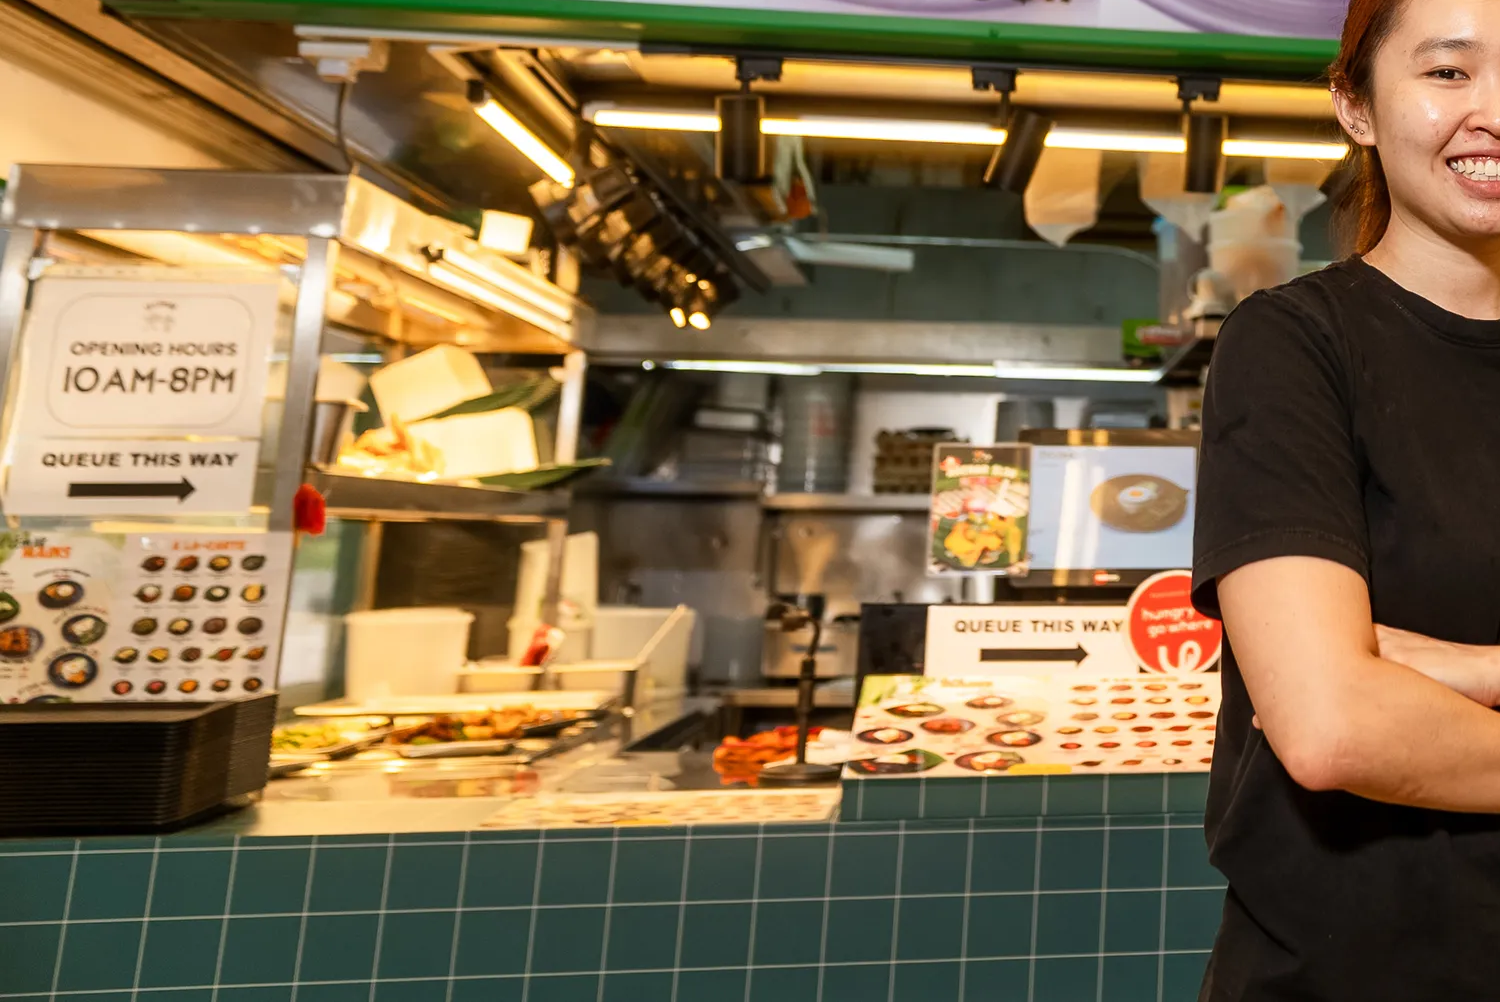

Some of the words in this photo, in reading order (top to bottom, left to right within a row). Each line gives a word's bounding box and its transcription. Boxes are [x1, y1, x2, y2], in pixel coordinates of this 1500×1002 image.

[70, 341, 163, 357] OPENING
[168, 342, 239, 358] HOURS
[41, 452, 122, 468] QUEUE
[130, 452, 182, 468] THIS
[188, 452, 240, 468] WAY
[1141, 607, 1197, 622] hungry
[954, 619, 1022, 634] QUEUE
[1032, 619, 1075, 633] THIS
[1082, 619, 1124, 633] WAY
